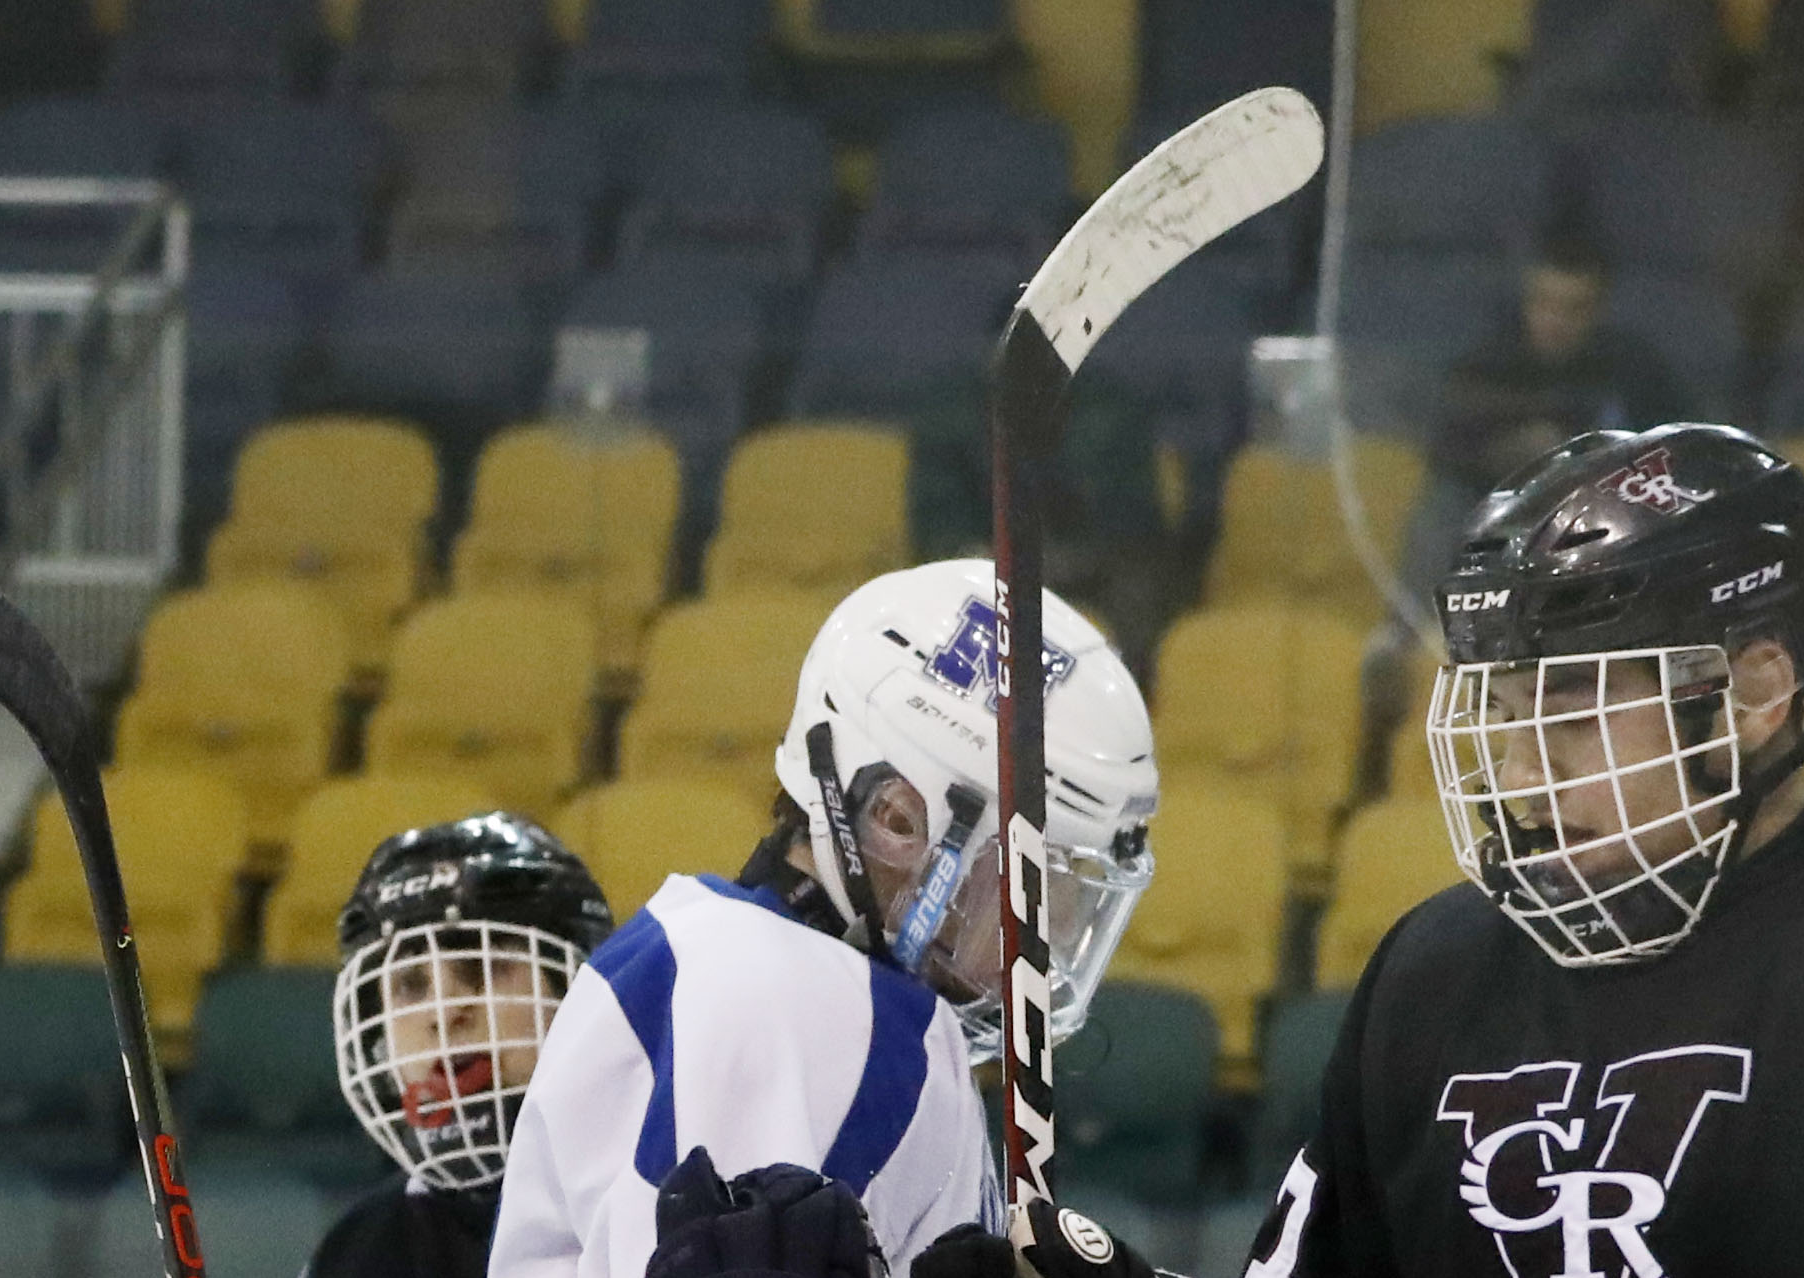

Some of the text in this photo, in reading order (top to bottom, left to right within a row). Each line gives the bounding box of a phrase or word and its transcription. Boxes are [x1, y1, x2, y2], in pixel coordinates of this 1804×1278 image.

[1446, 588, 1511, 612] CCM
[1710, 560, 1785, 603] CCM
[996, 576, 1010, 698] CCM
